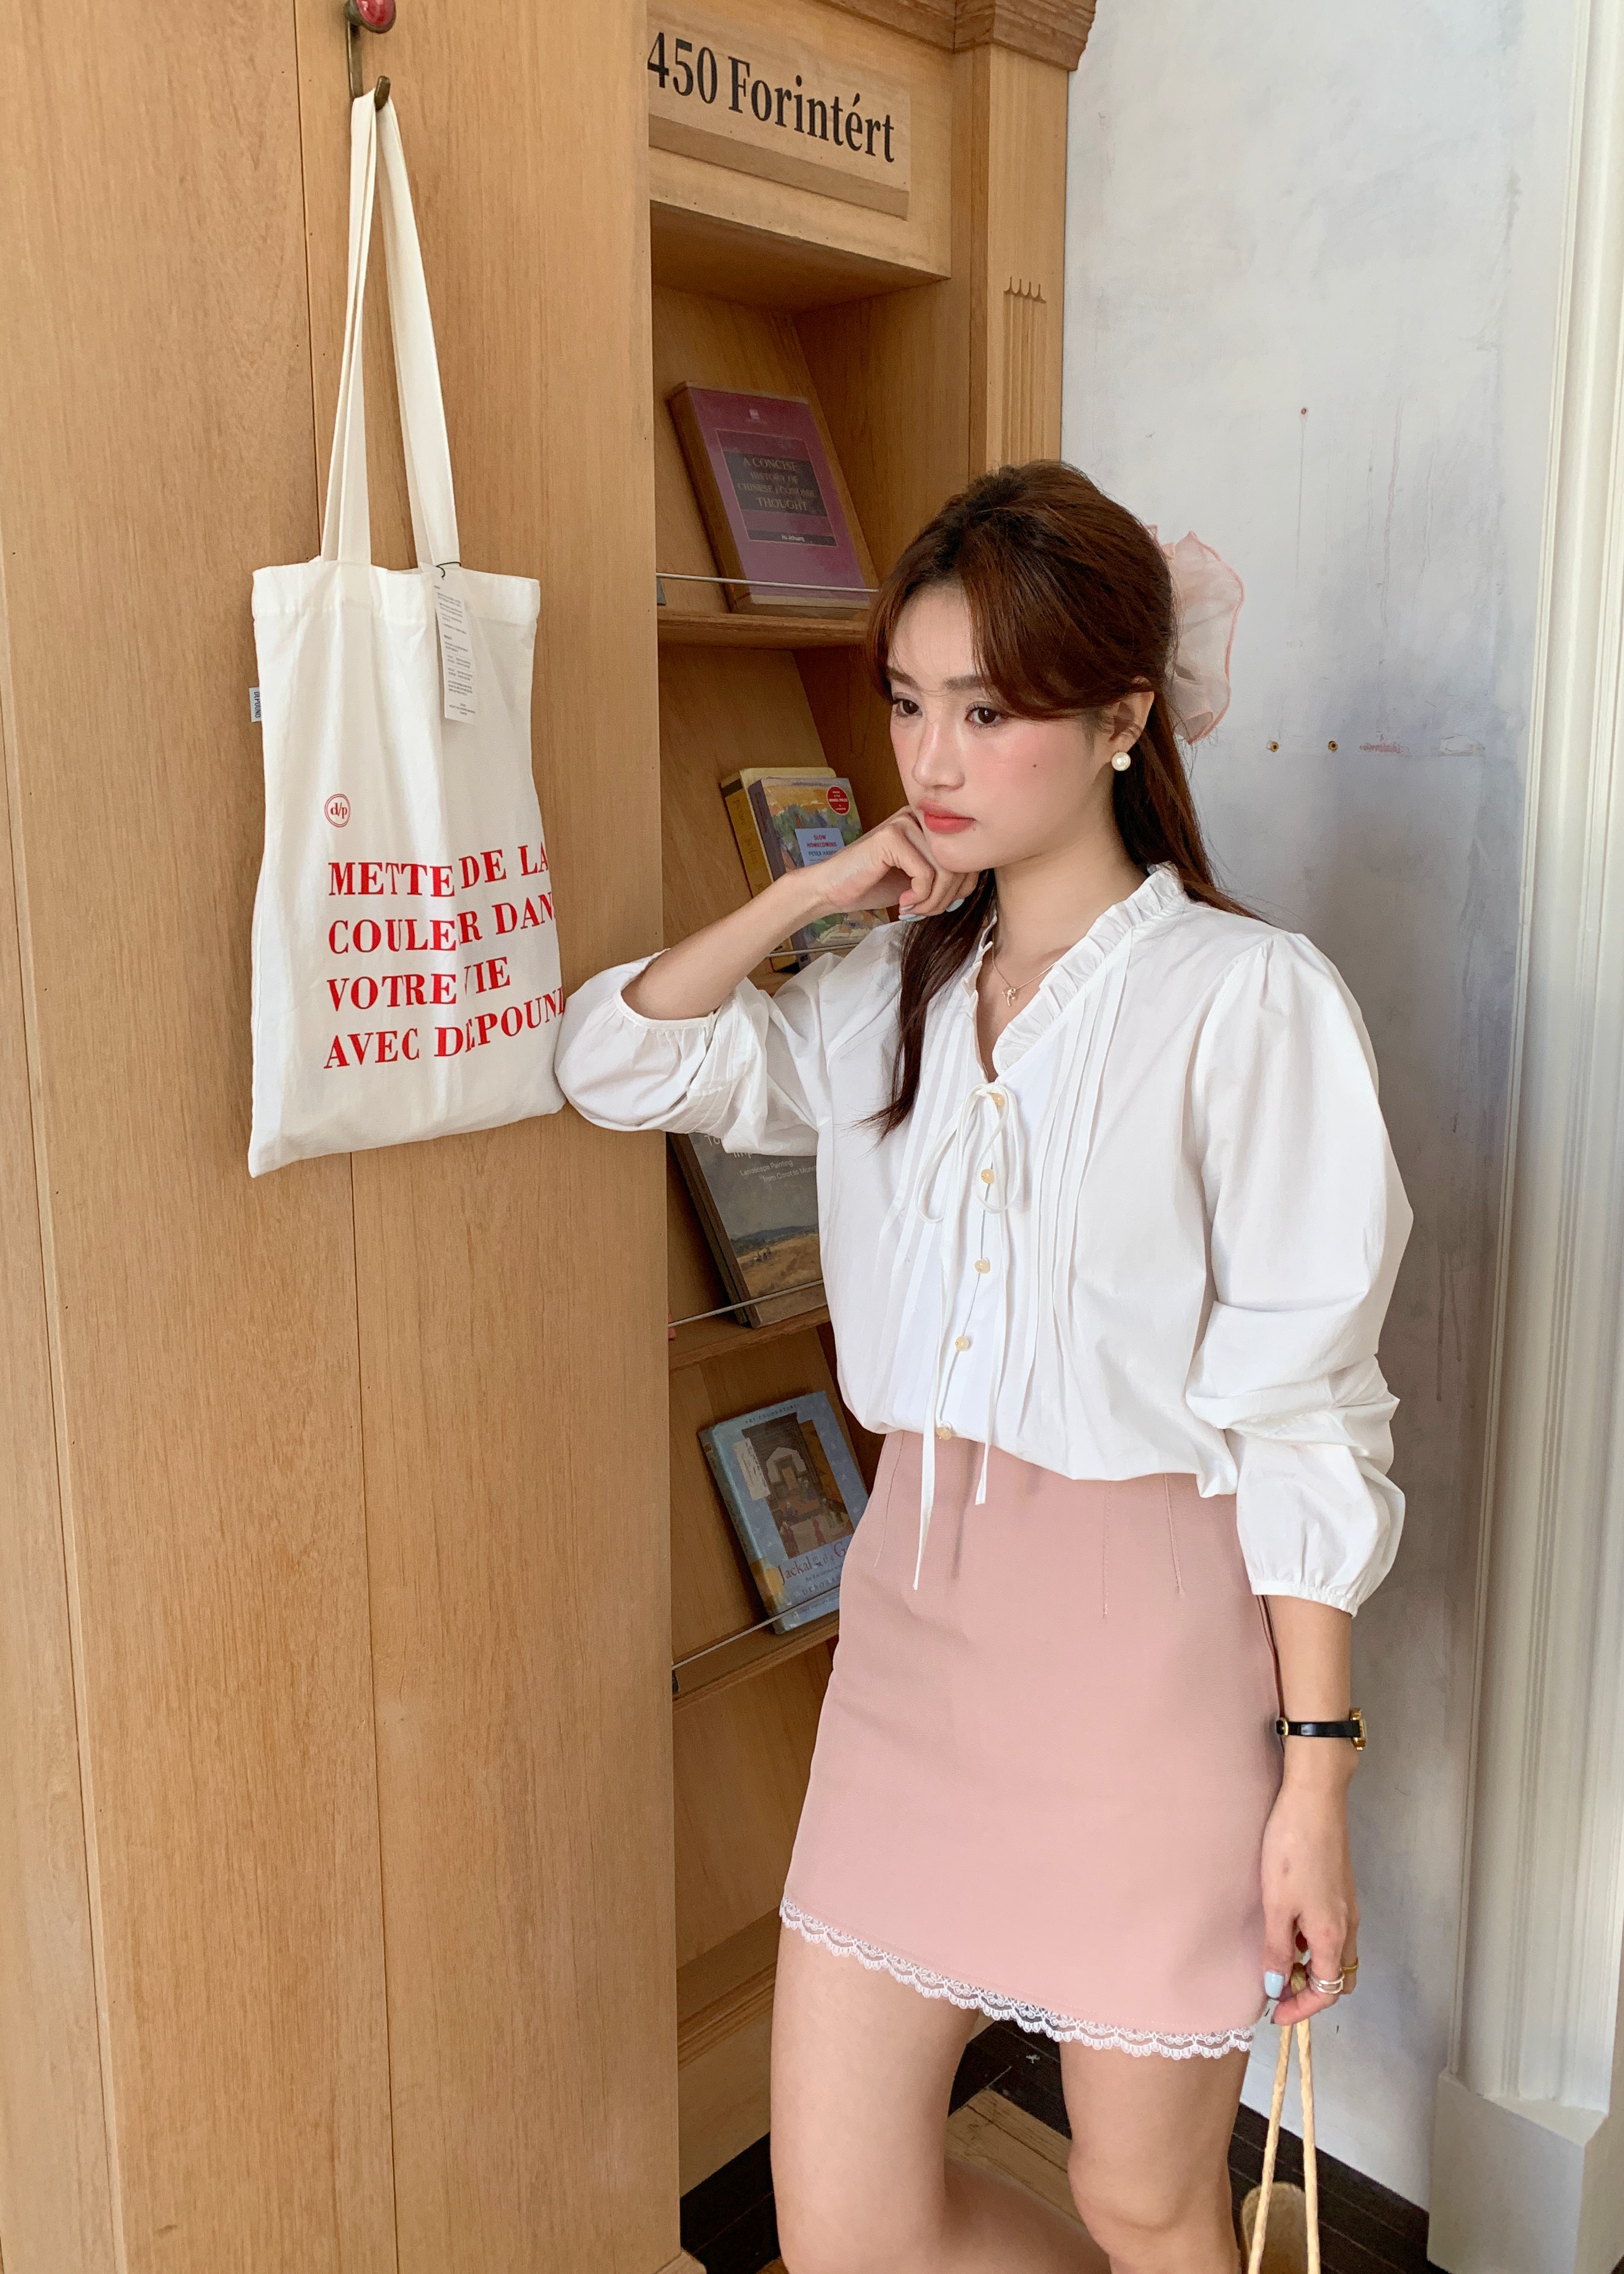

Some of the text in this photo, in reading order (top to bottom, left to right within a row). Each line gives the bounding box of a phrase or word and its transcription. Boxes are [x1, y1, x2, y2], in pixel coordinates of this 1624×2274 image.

[647, 32, 895, 163] 450 Forintért
[757, 497, 808, 511] THOUGHT
[459, 849, 507, 889] DE
[518, 841, 549, 876] LA
[328, 910, 483, 955] COULER
[326, 973, 457, 1012] VOTRE
[323, 1027, 421, 1069] AVEC
